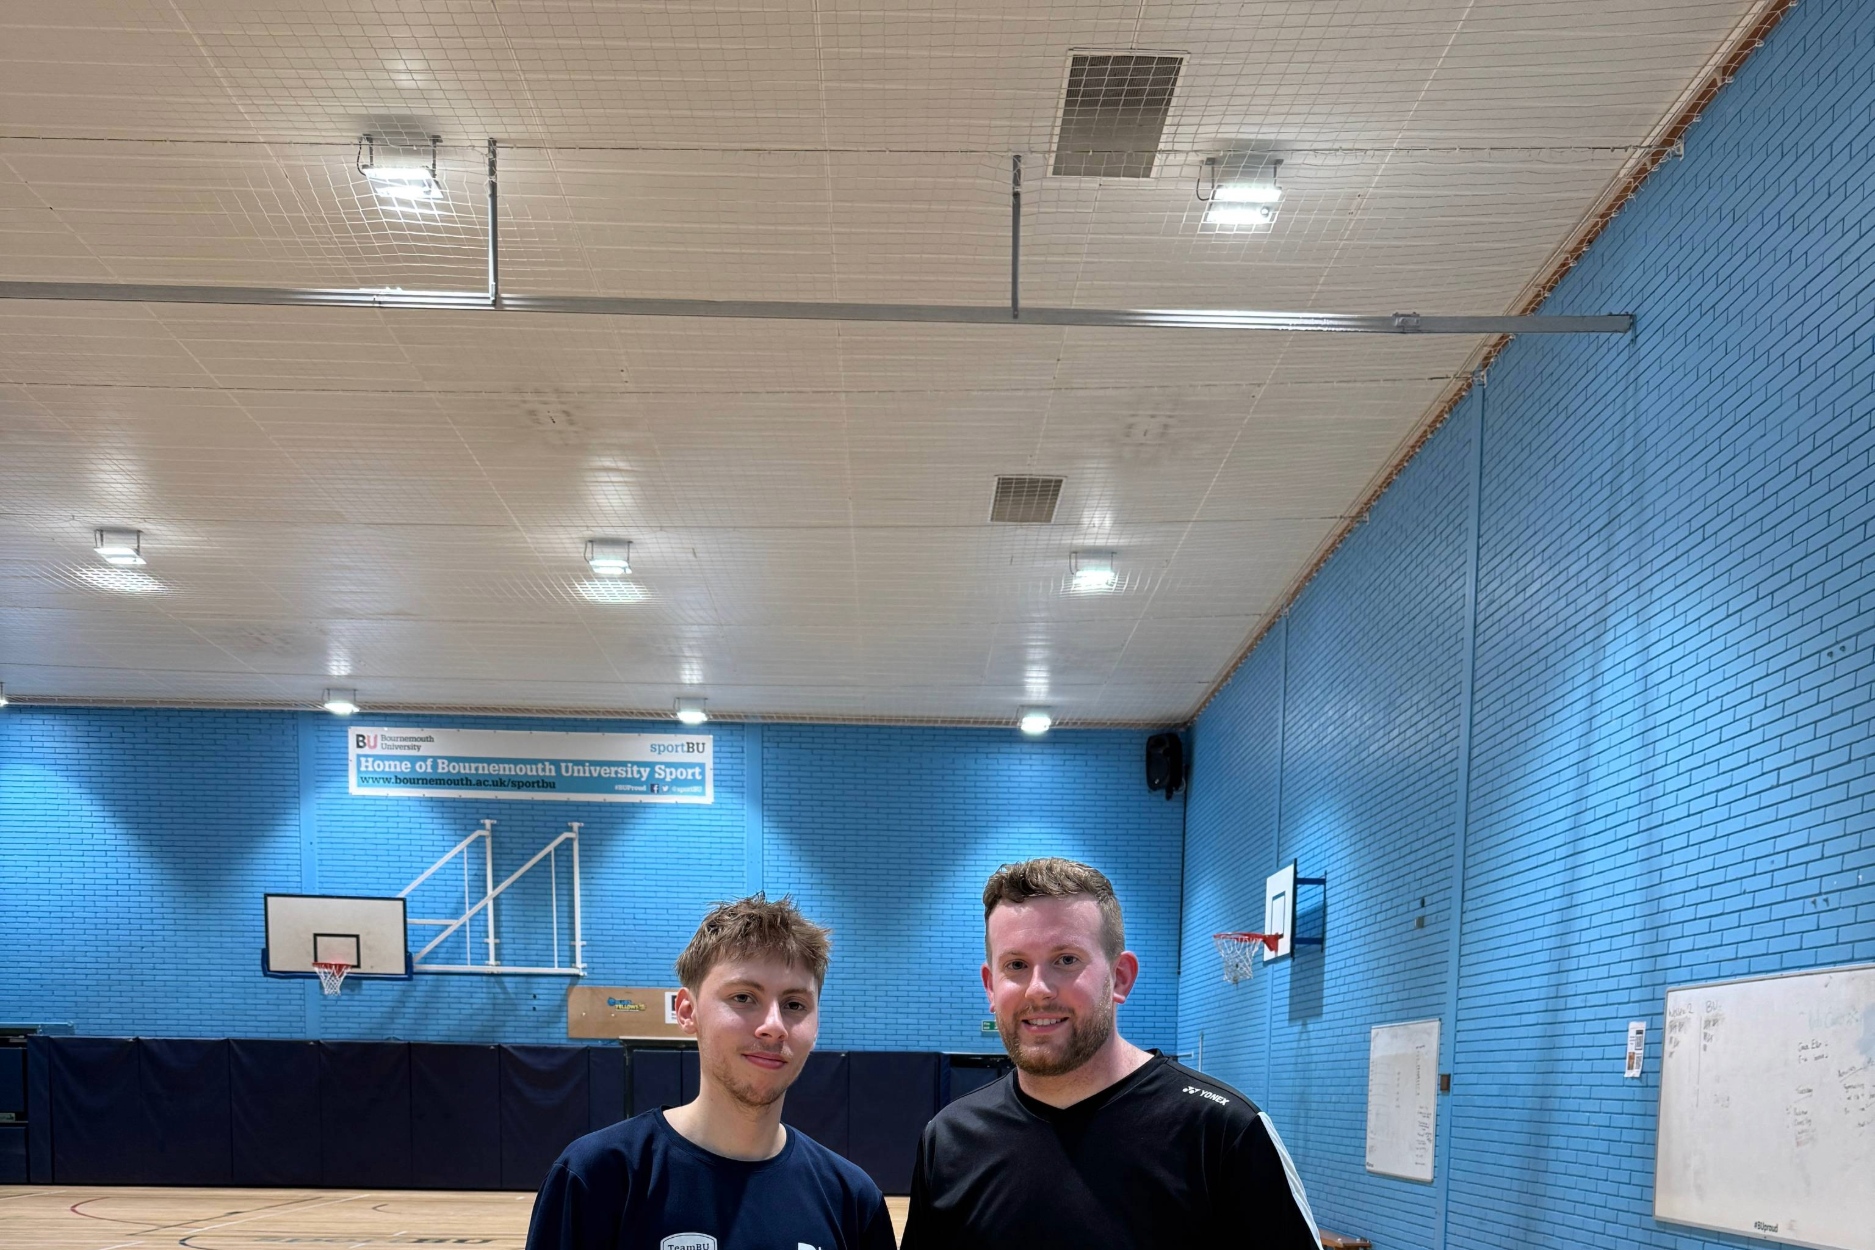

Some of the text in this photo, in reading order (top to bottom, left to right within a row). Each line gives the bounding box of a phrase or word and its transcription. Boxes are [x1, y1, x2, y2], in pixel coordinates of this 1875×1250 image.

[356, 734, 378, 749] BU
[380, 734, 435, 743] Bournemouth
[381, 743, 422, 752] University
[650, 742, 706, 754] sportBU
[360, 757, 702, 782] Home of Bournemouth University Sport
[359, 774, 556, 790] www.bournemouth.ac.uk/sportbu
[1200, 1090, 1230, 1106] YONEX
